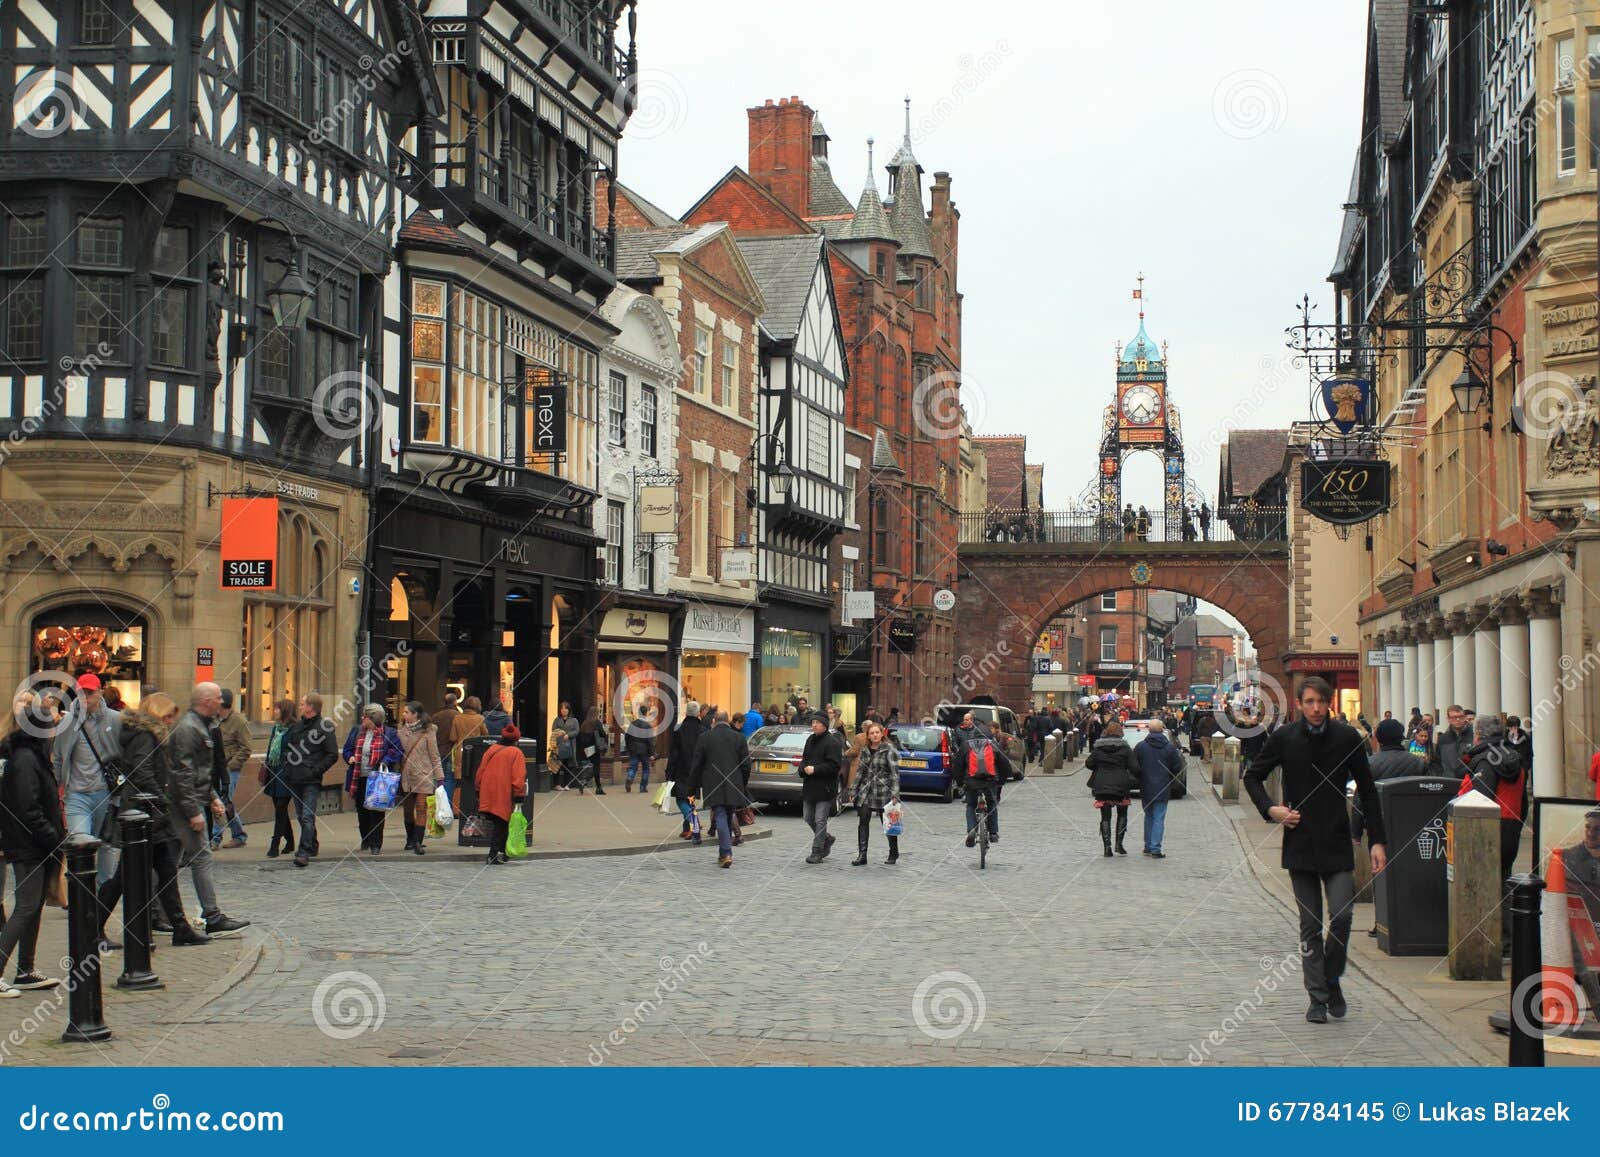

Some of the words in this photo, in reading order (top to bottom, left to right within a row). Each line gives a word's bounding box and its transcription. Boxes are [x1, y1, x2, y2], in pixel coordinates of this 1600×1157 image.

[538, 394, 554, 447] next
[1322, 466, 1369, 495] 150
[500, 538, 530, 565] next
[229, 561, 266, 575] SOLE
[229, 577, 265, 586] TRADER
